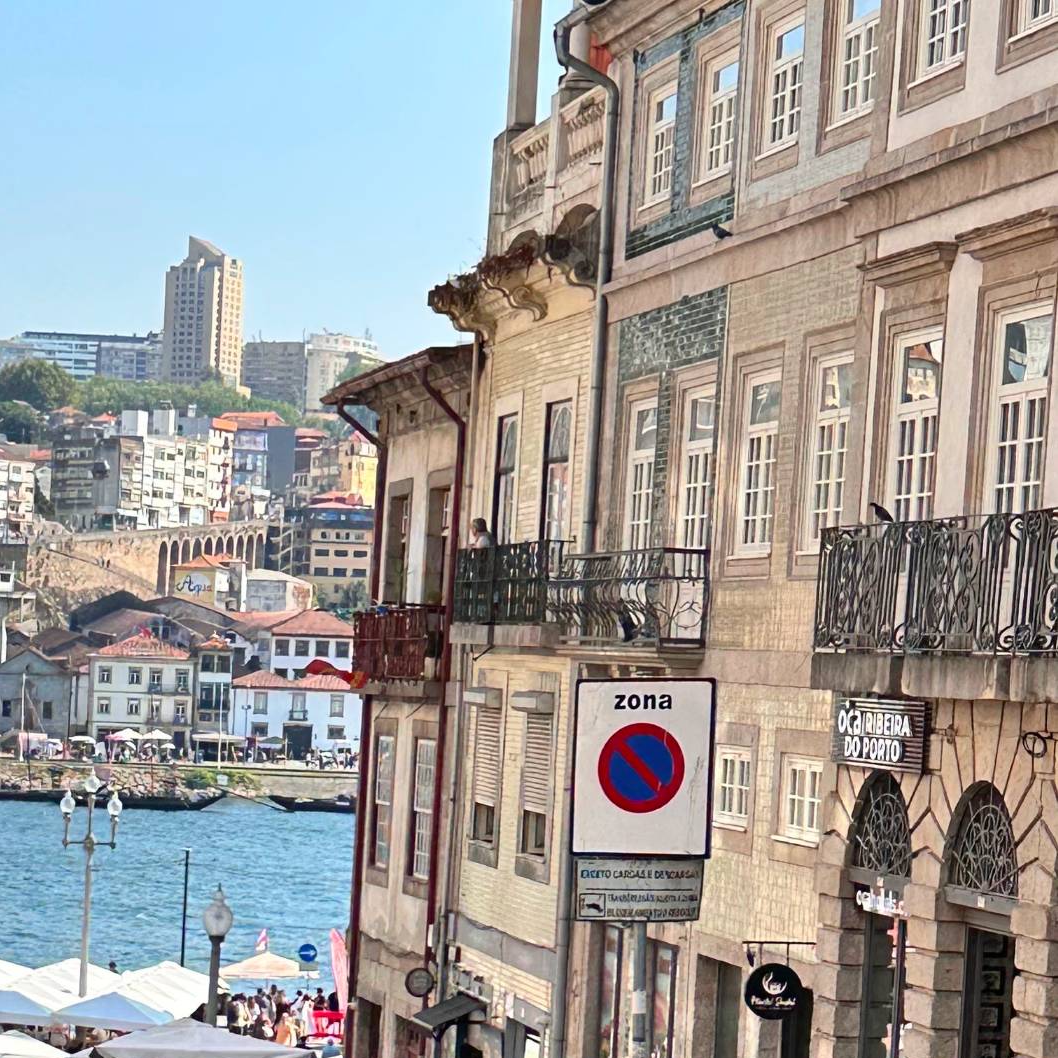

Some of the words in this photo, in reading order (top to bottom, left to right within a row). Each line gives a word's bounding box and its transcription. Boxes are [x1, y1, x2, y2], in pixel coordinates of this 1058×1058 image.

[614, 694, 672, 710] zona
[865, 712, 912, 737] RIBEIRA
[844, 735, 861, 758] DO
[862, 737, 901, 762] PORTO
